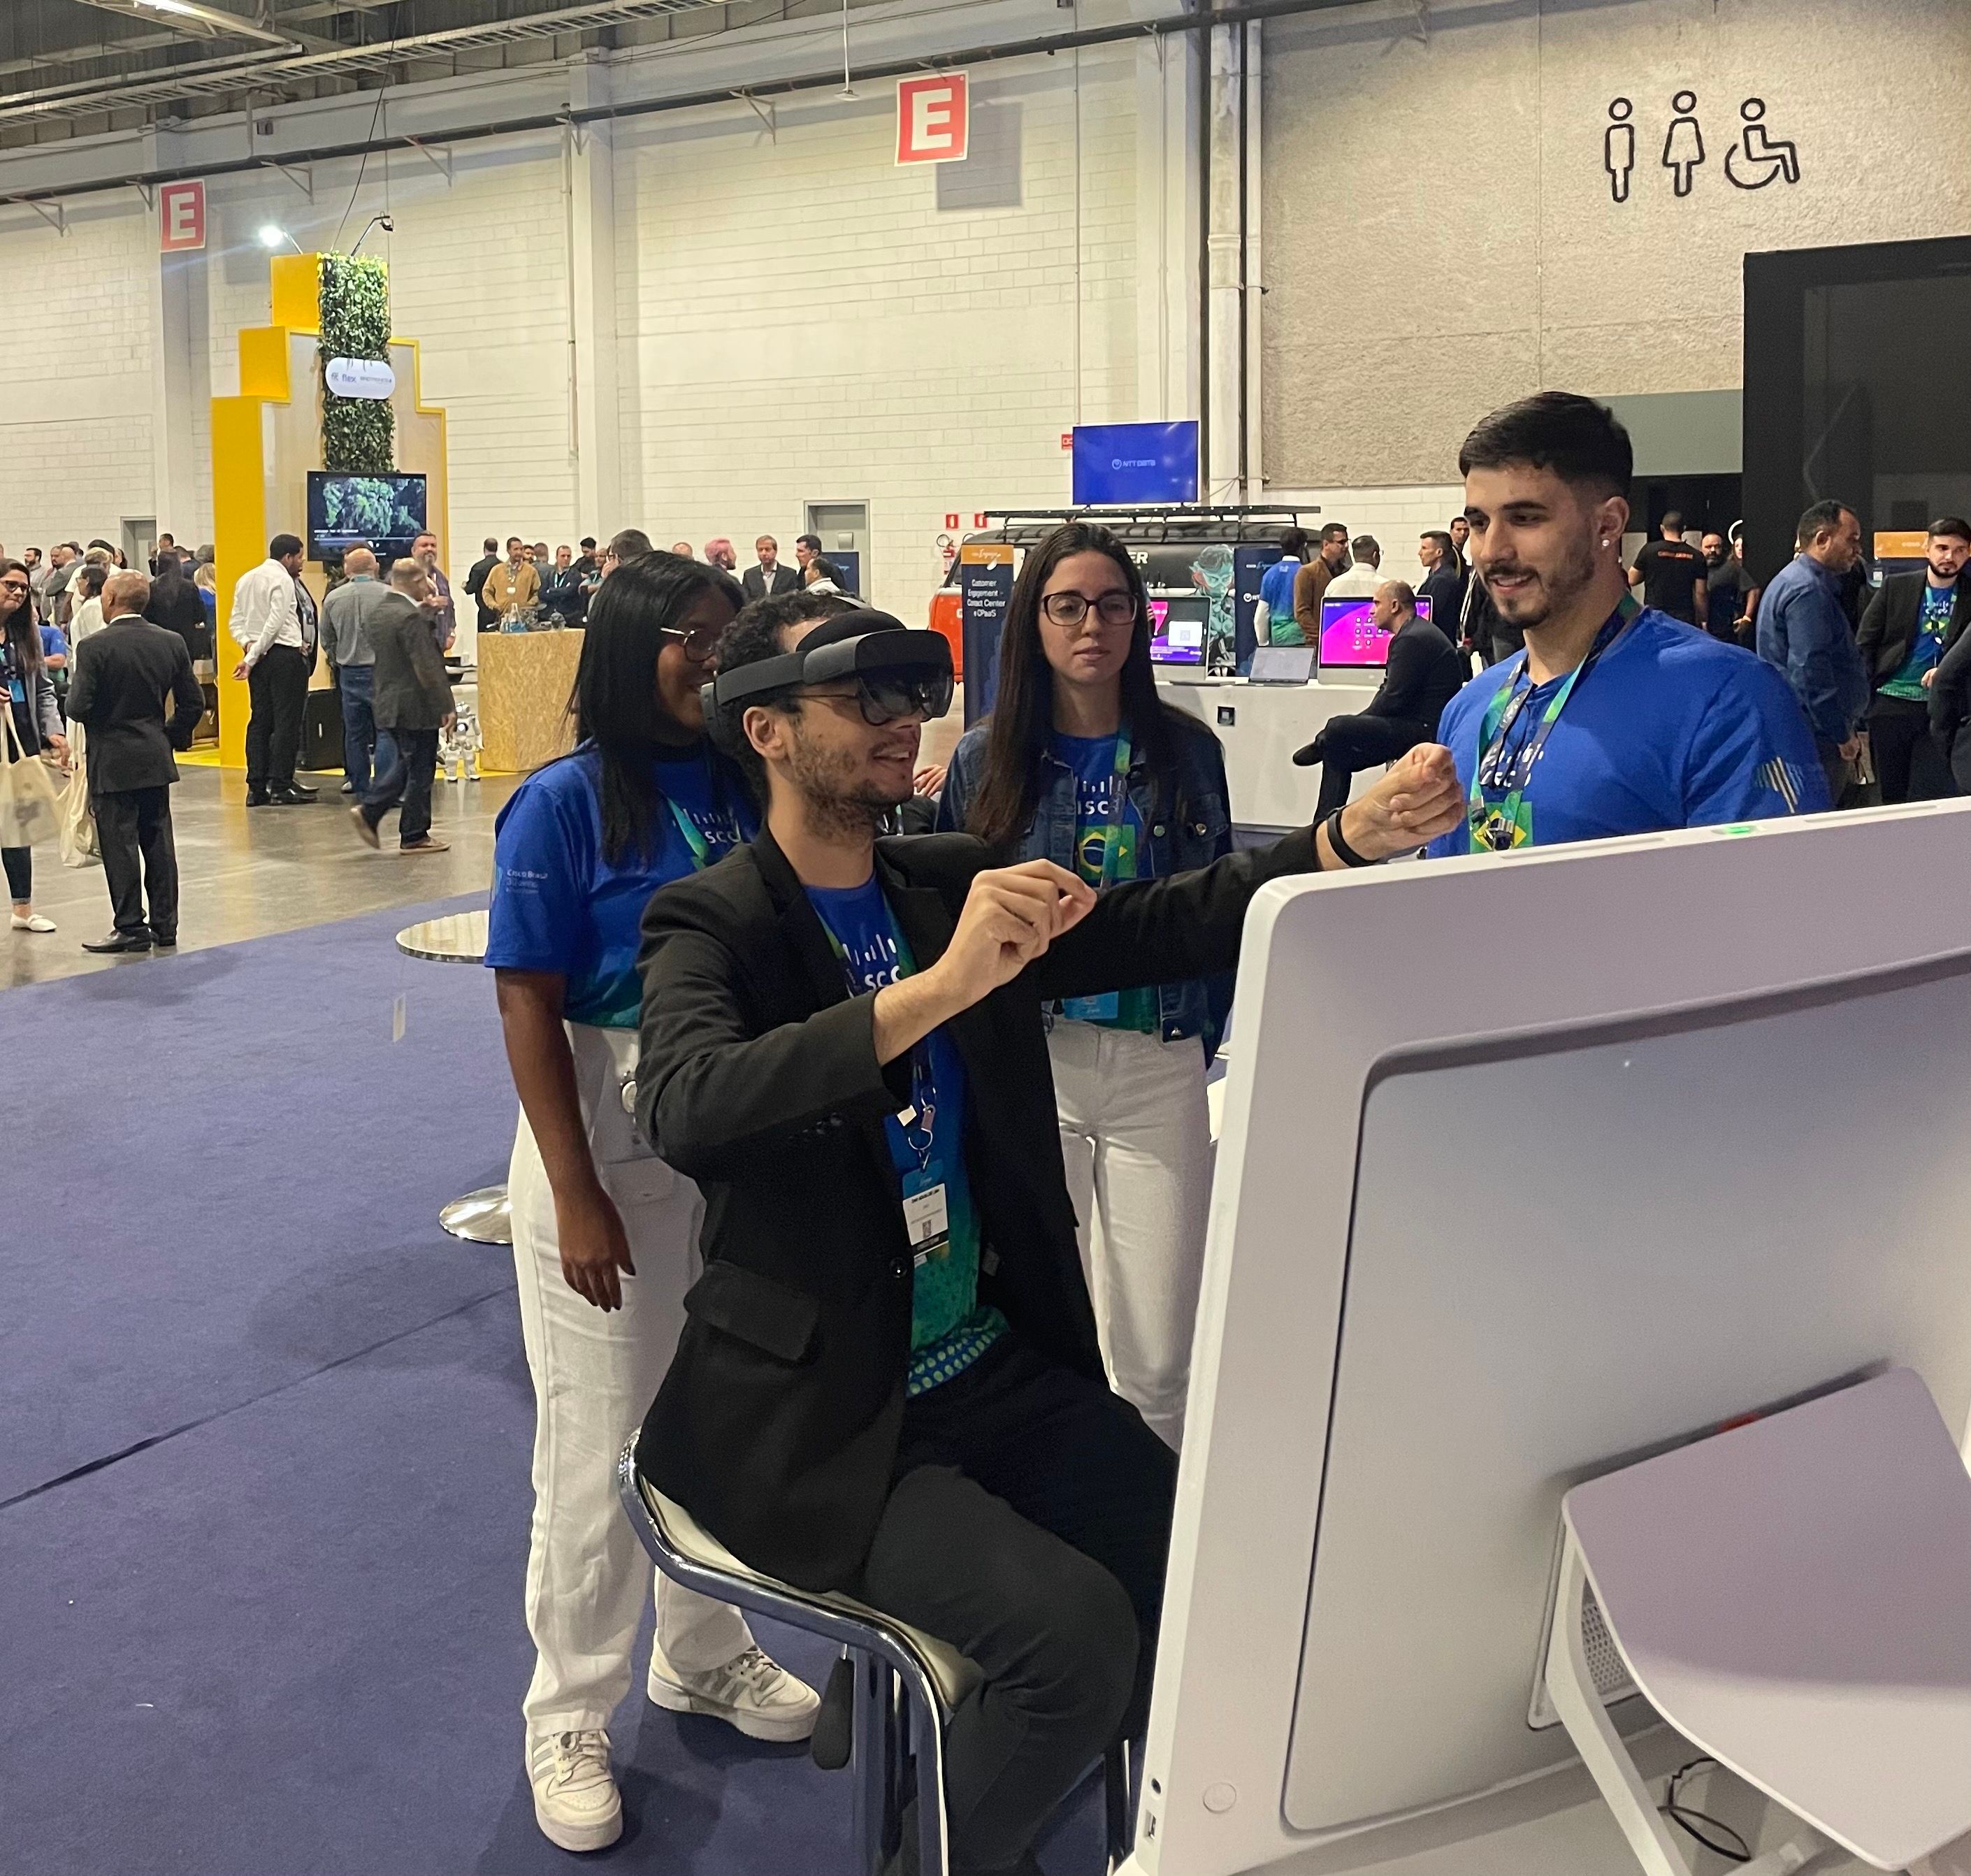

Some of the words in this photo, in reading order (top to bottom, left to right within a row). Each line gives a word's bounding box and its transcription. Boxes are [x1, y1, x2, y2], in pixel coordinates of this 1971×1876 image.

[911, 88, 952, 151] E
[169, 192, 196, 240] E
[983, 598, 1006, 607] Center
